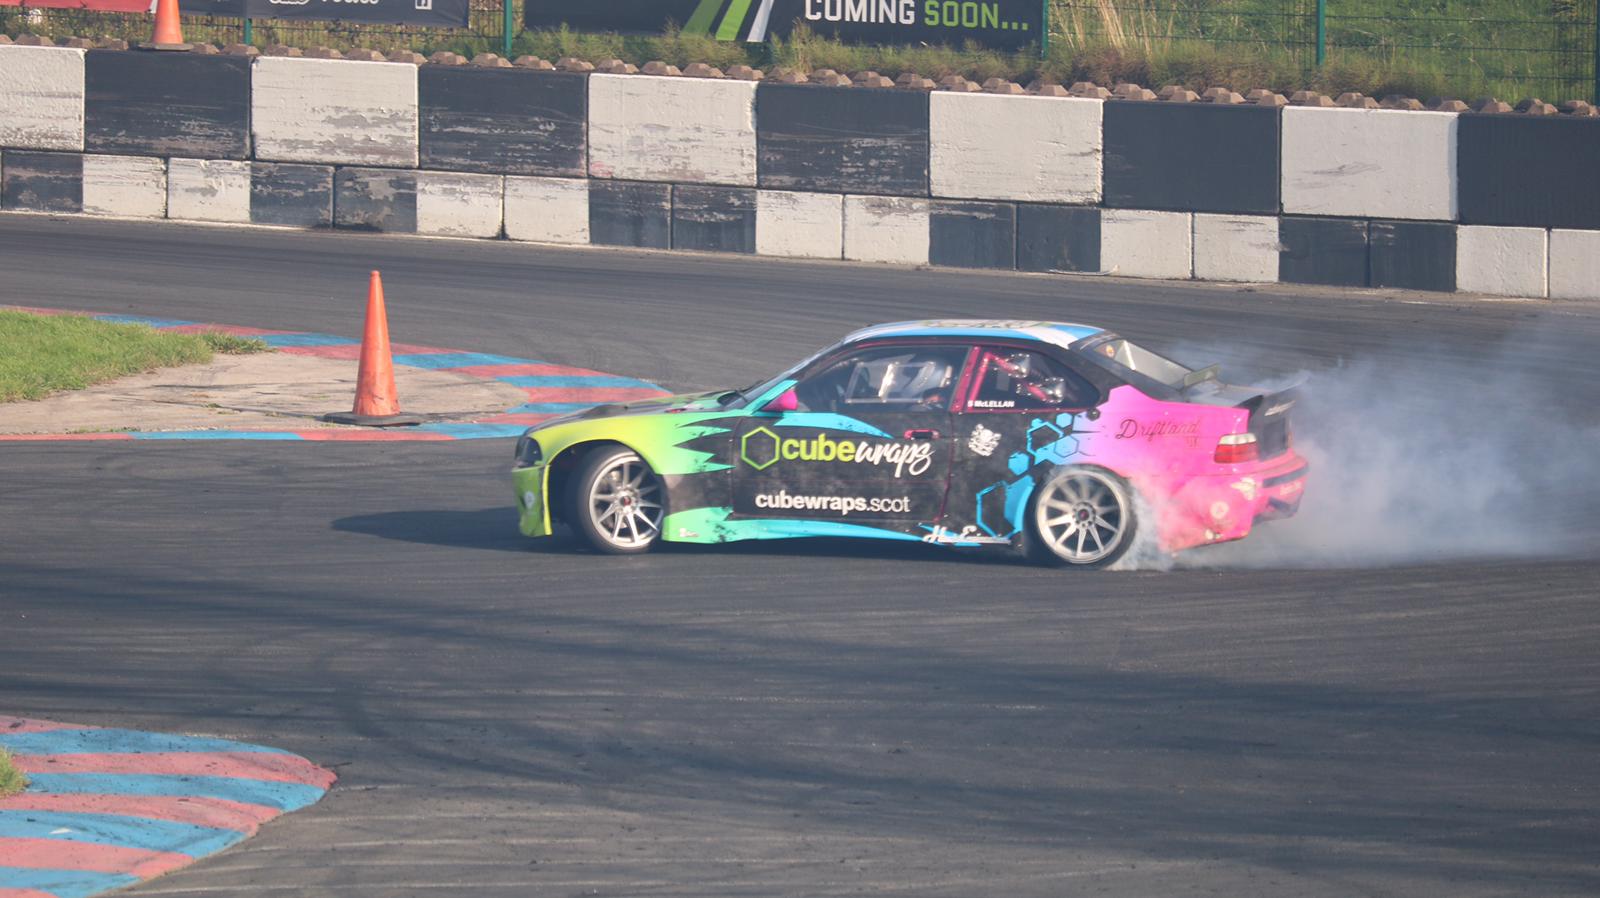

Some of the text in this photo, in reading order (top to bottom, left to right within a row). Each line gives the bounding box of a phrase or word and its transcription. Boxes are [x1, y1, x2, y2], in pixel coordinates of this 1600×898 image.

[805, 0, 1029, 31] COMING SOON...
[974, 400, 1015, 408] McLELLAN
[781, 433, 935, 478] cubewraps
[755, 490, 911, 515] cubewraps.scot
